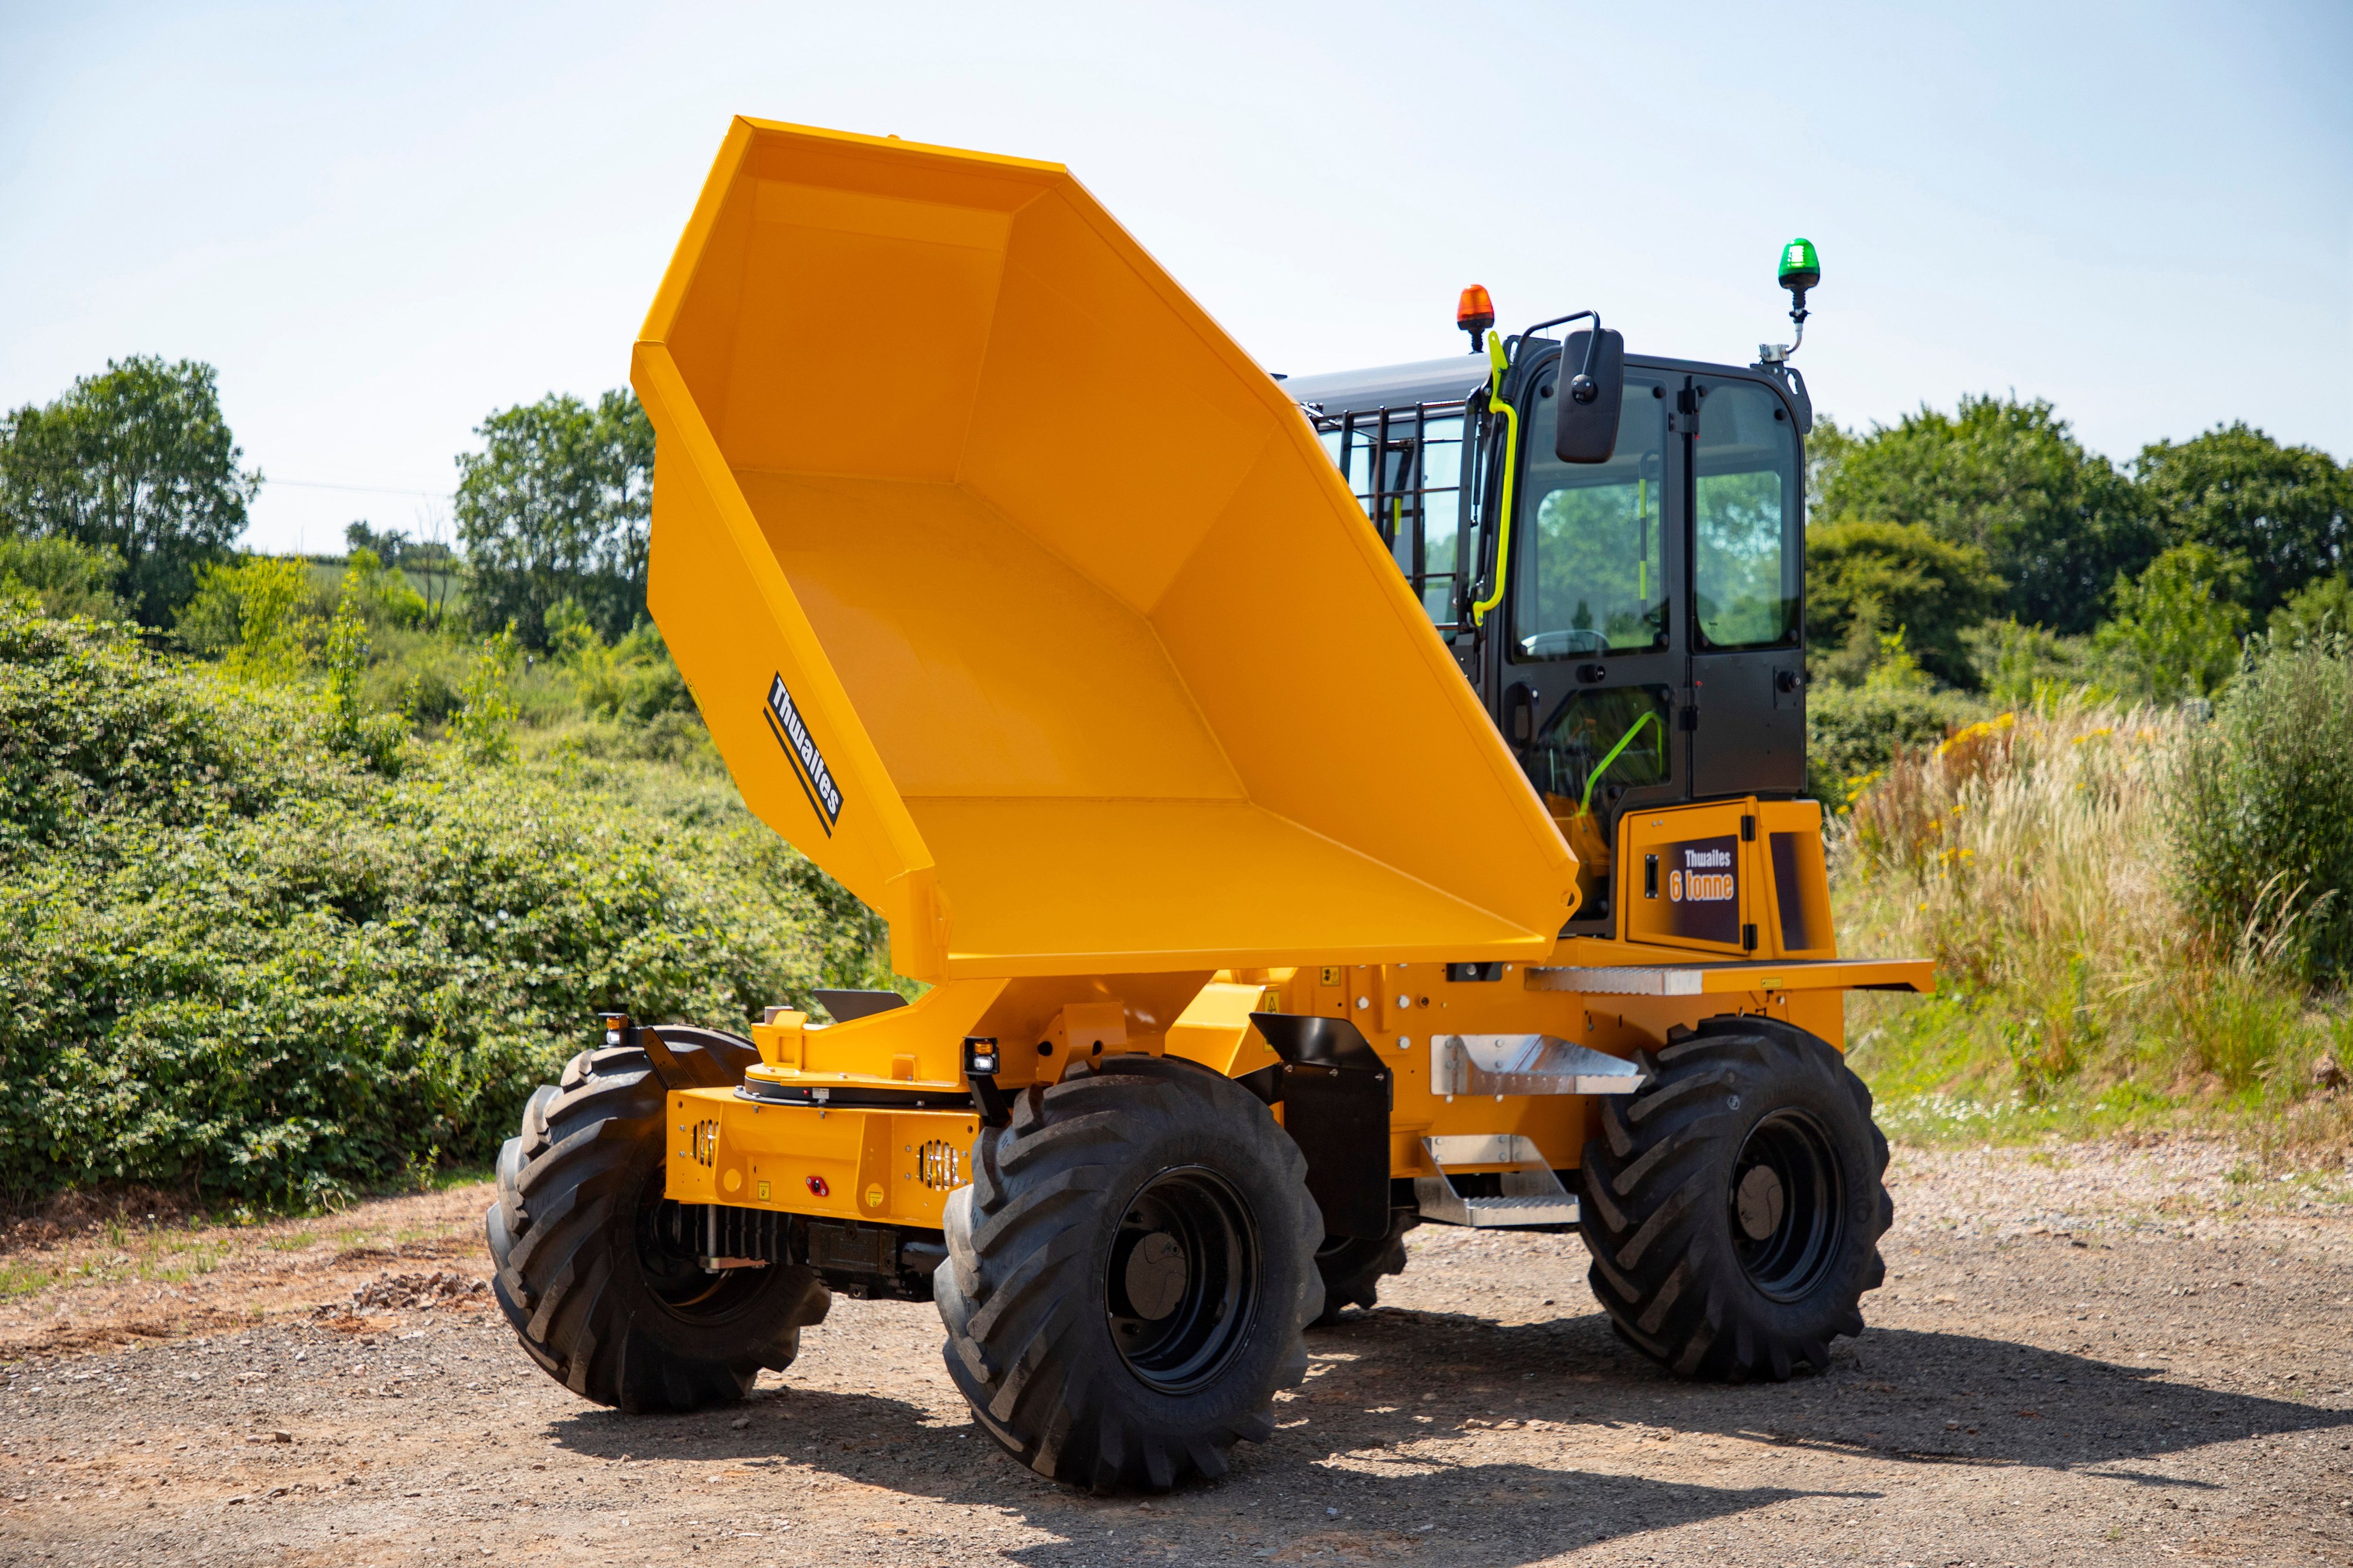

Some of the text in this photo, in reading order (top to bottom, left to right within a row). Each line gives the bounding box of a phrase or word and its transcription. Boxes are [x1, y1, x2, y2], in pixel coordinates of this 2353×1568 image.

[773, 676, 838, 815] Thwaites
[1685, 849, 1730, 867] Thwaites
[1670, 869, 1734, 902] 6 tonne
